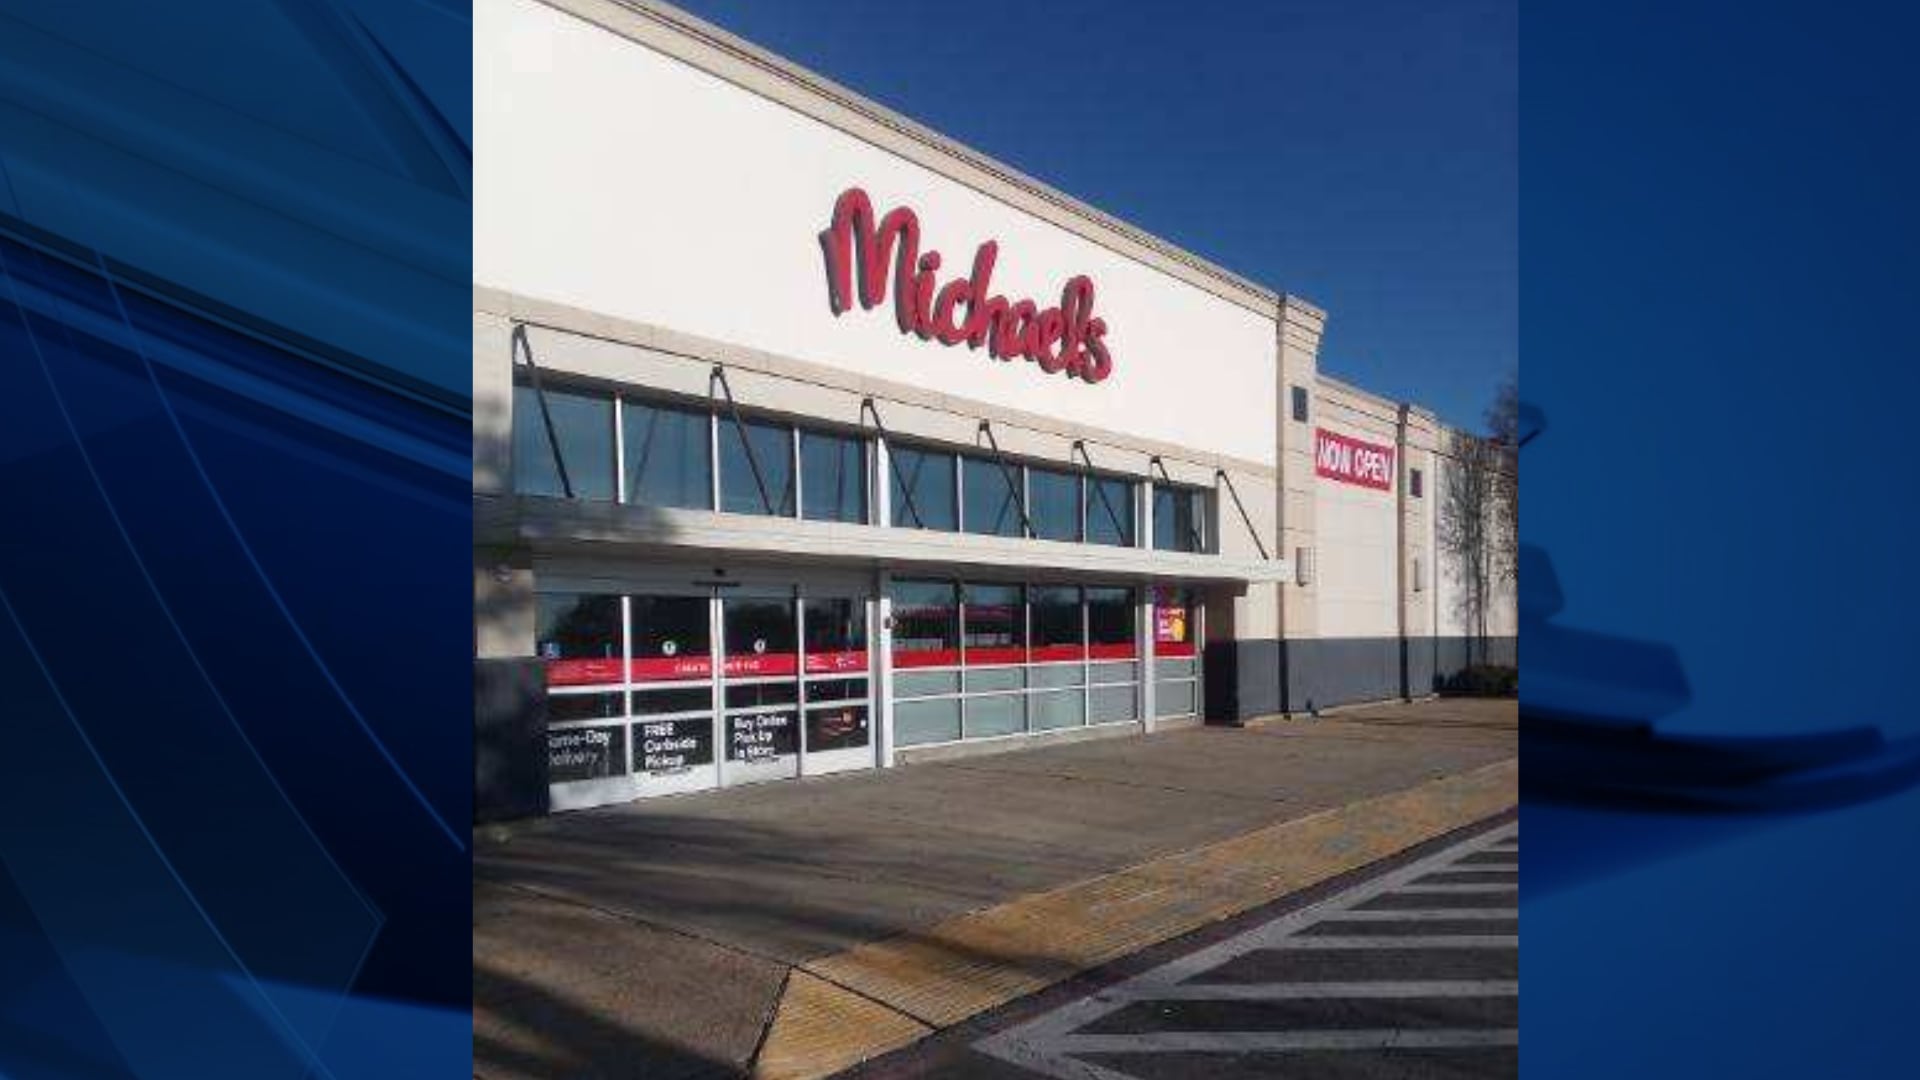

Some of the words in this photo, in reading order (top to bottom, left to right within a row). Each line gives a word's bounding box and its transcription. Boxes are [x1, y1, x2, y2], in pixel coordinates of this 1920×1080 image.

[819, 188, 1112, 384] Michaels
[1318, 435, 1351, 475] NOW
[1355, 447, 1391, 484] OPEN
[643, 722, 675, 737] FREE
